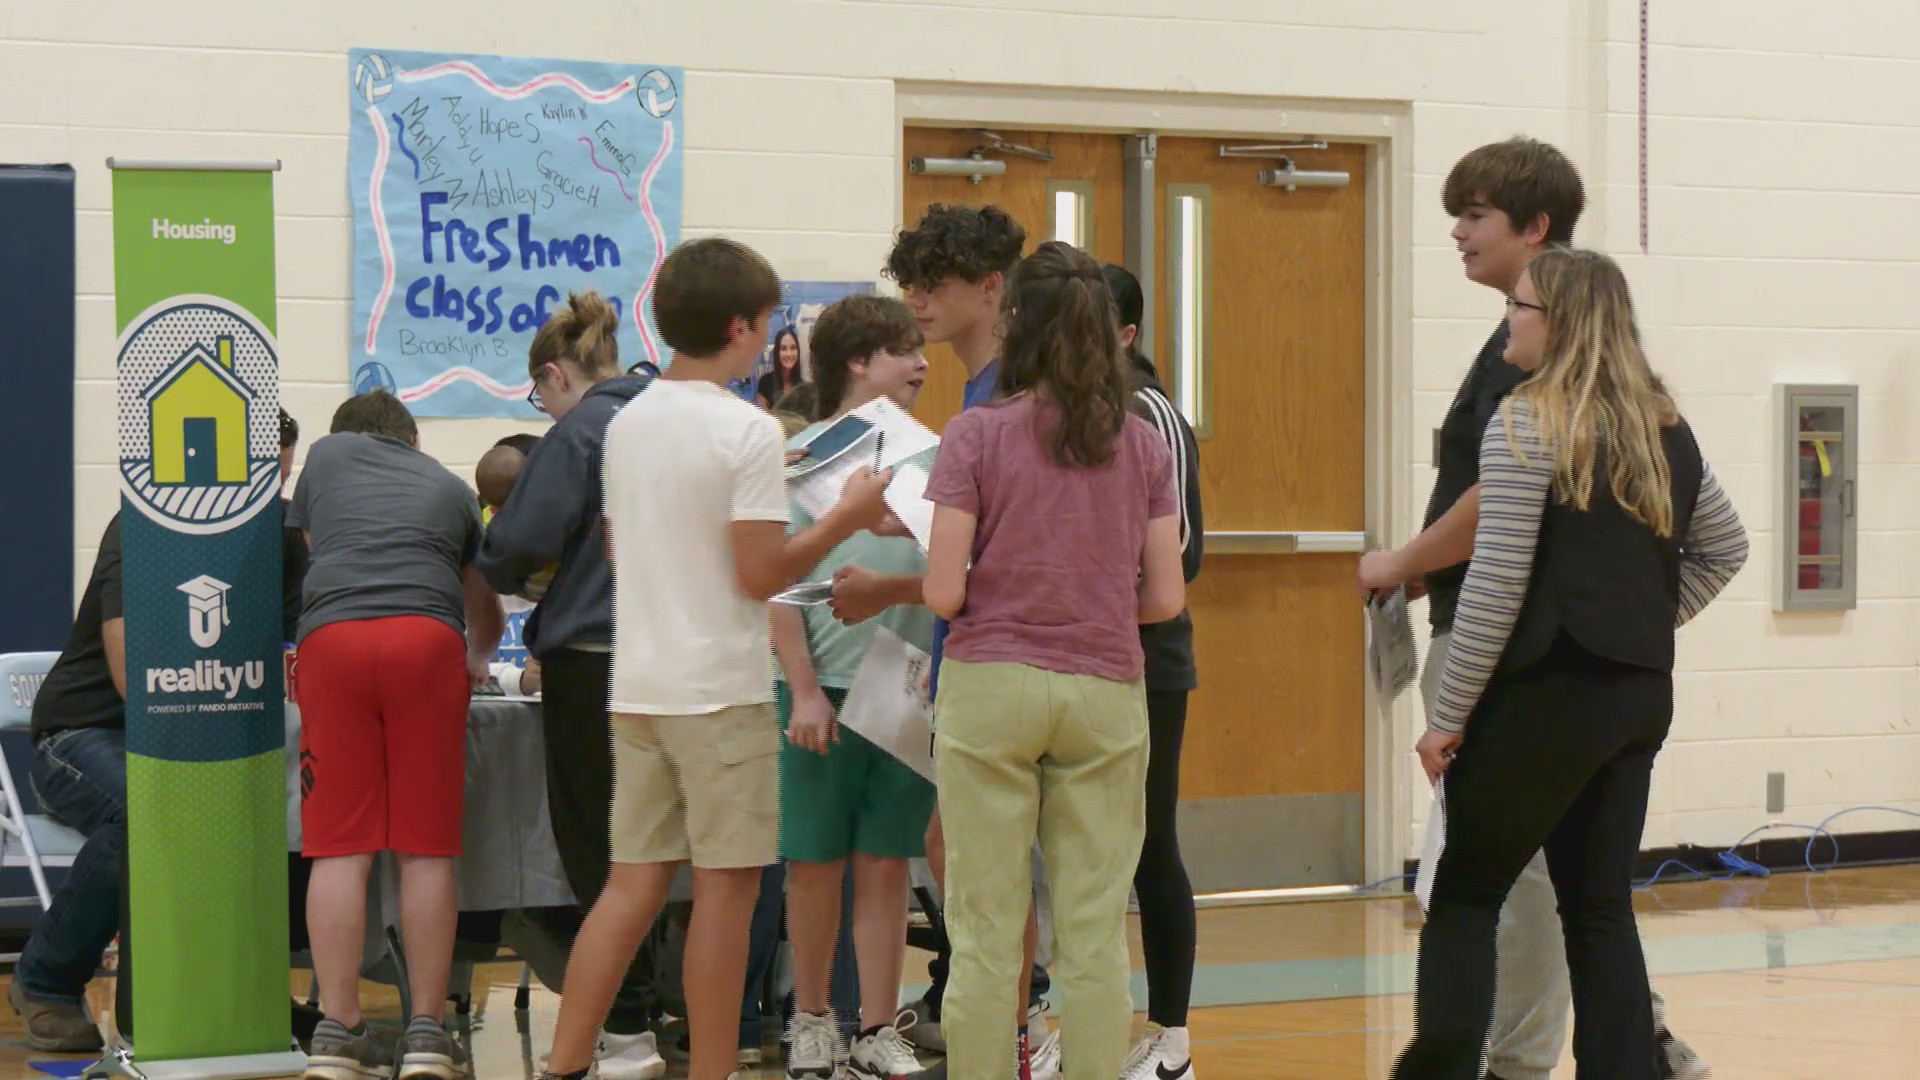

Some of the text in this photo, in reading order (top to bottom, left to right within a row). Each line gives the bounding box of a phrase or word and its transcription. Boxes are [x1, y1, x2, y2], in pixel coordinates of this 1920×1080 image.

[480, 106, 523, 143] Hope
[541, 103, 576, 123] Kaylin
[400, 96, 445, 185] Marley
[471, 166, 554, 216] Ashley S
[536, 150, 586, 202] Gracie
[152, 218, 236, 245] Housing
[420, 191, 621, 273] Freshmen
[405, 274, 503, 335] Class
[492, 338, 509, 357] B
[146, 659, 264, 699] realityU
[147, 701, 265, 714] POWERED BY PANDO INITIATIVE
